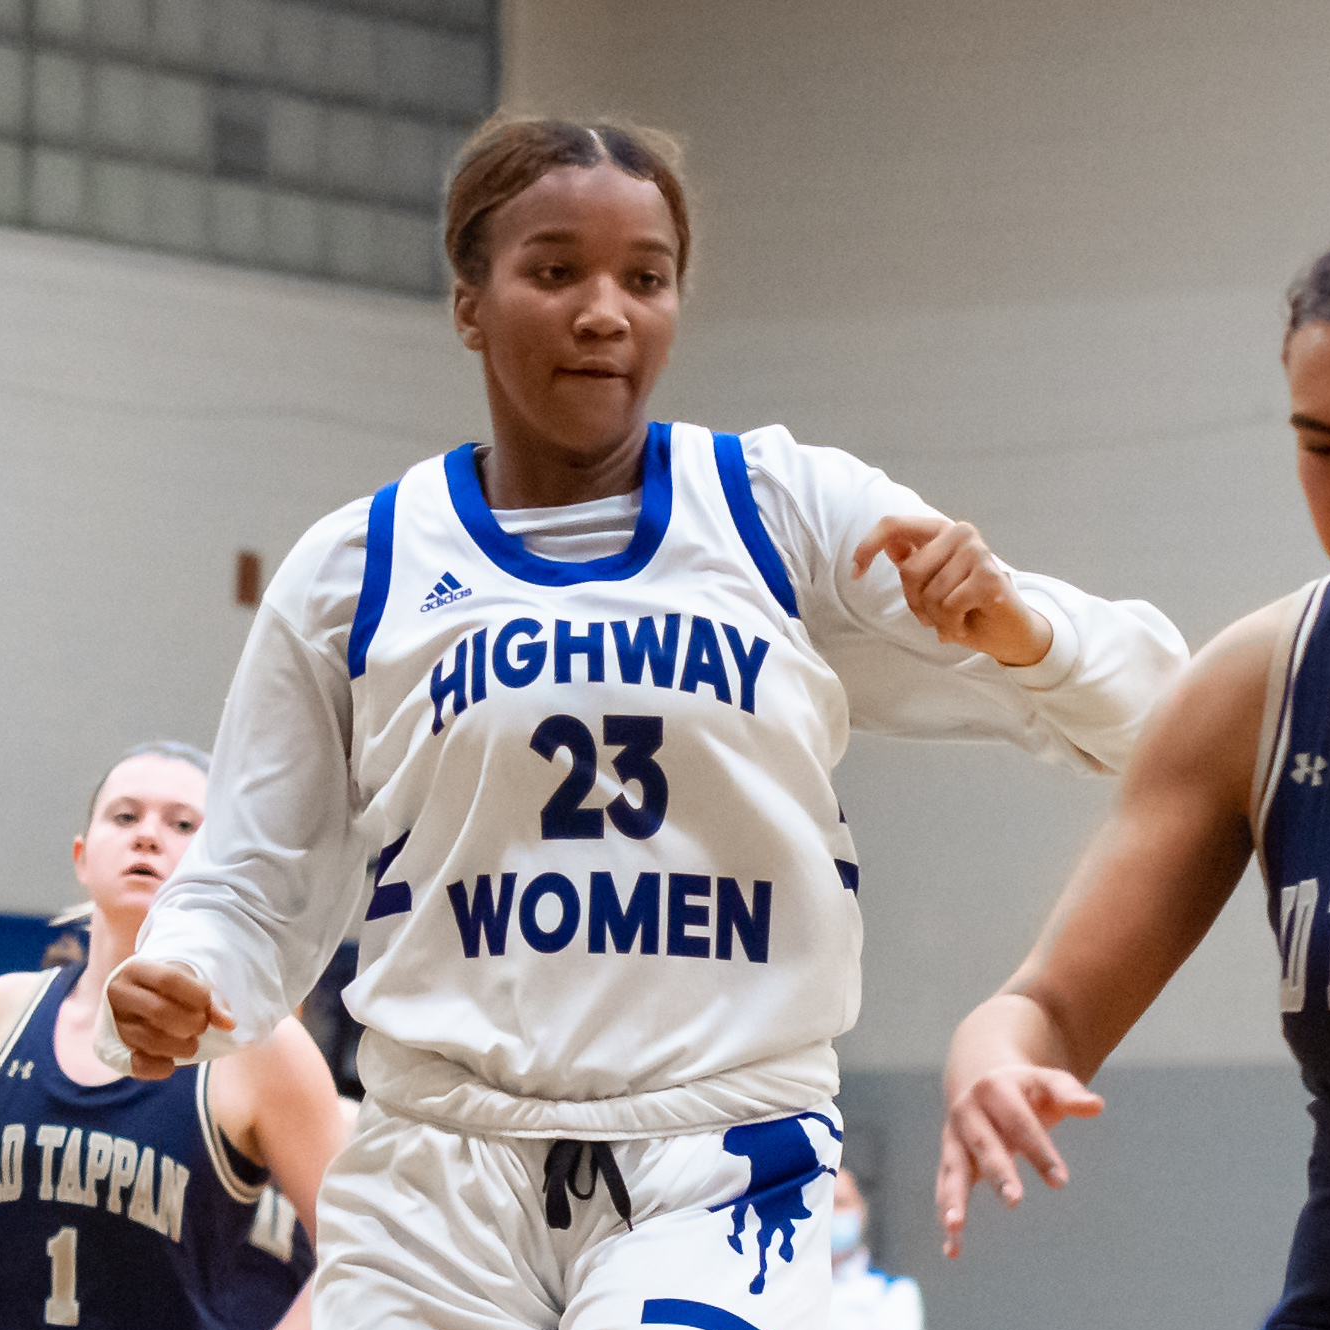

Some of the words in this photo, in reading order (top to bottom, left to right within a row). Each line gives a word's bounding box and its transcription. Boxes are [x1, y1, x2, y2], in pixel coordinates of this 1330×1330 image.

[420, 588, 472, 612] adidas
[430, 613, 771, 736] HIGHWAY
[529, 714, 669, 840] 23
[446, 872, 772, 964] WOMEN
[36, 1124, 191, 1243] TAPPAN
[44, 1225, 80, 1327] 1
